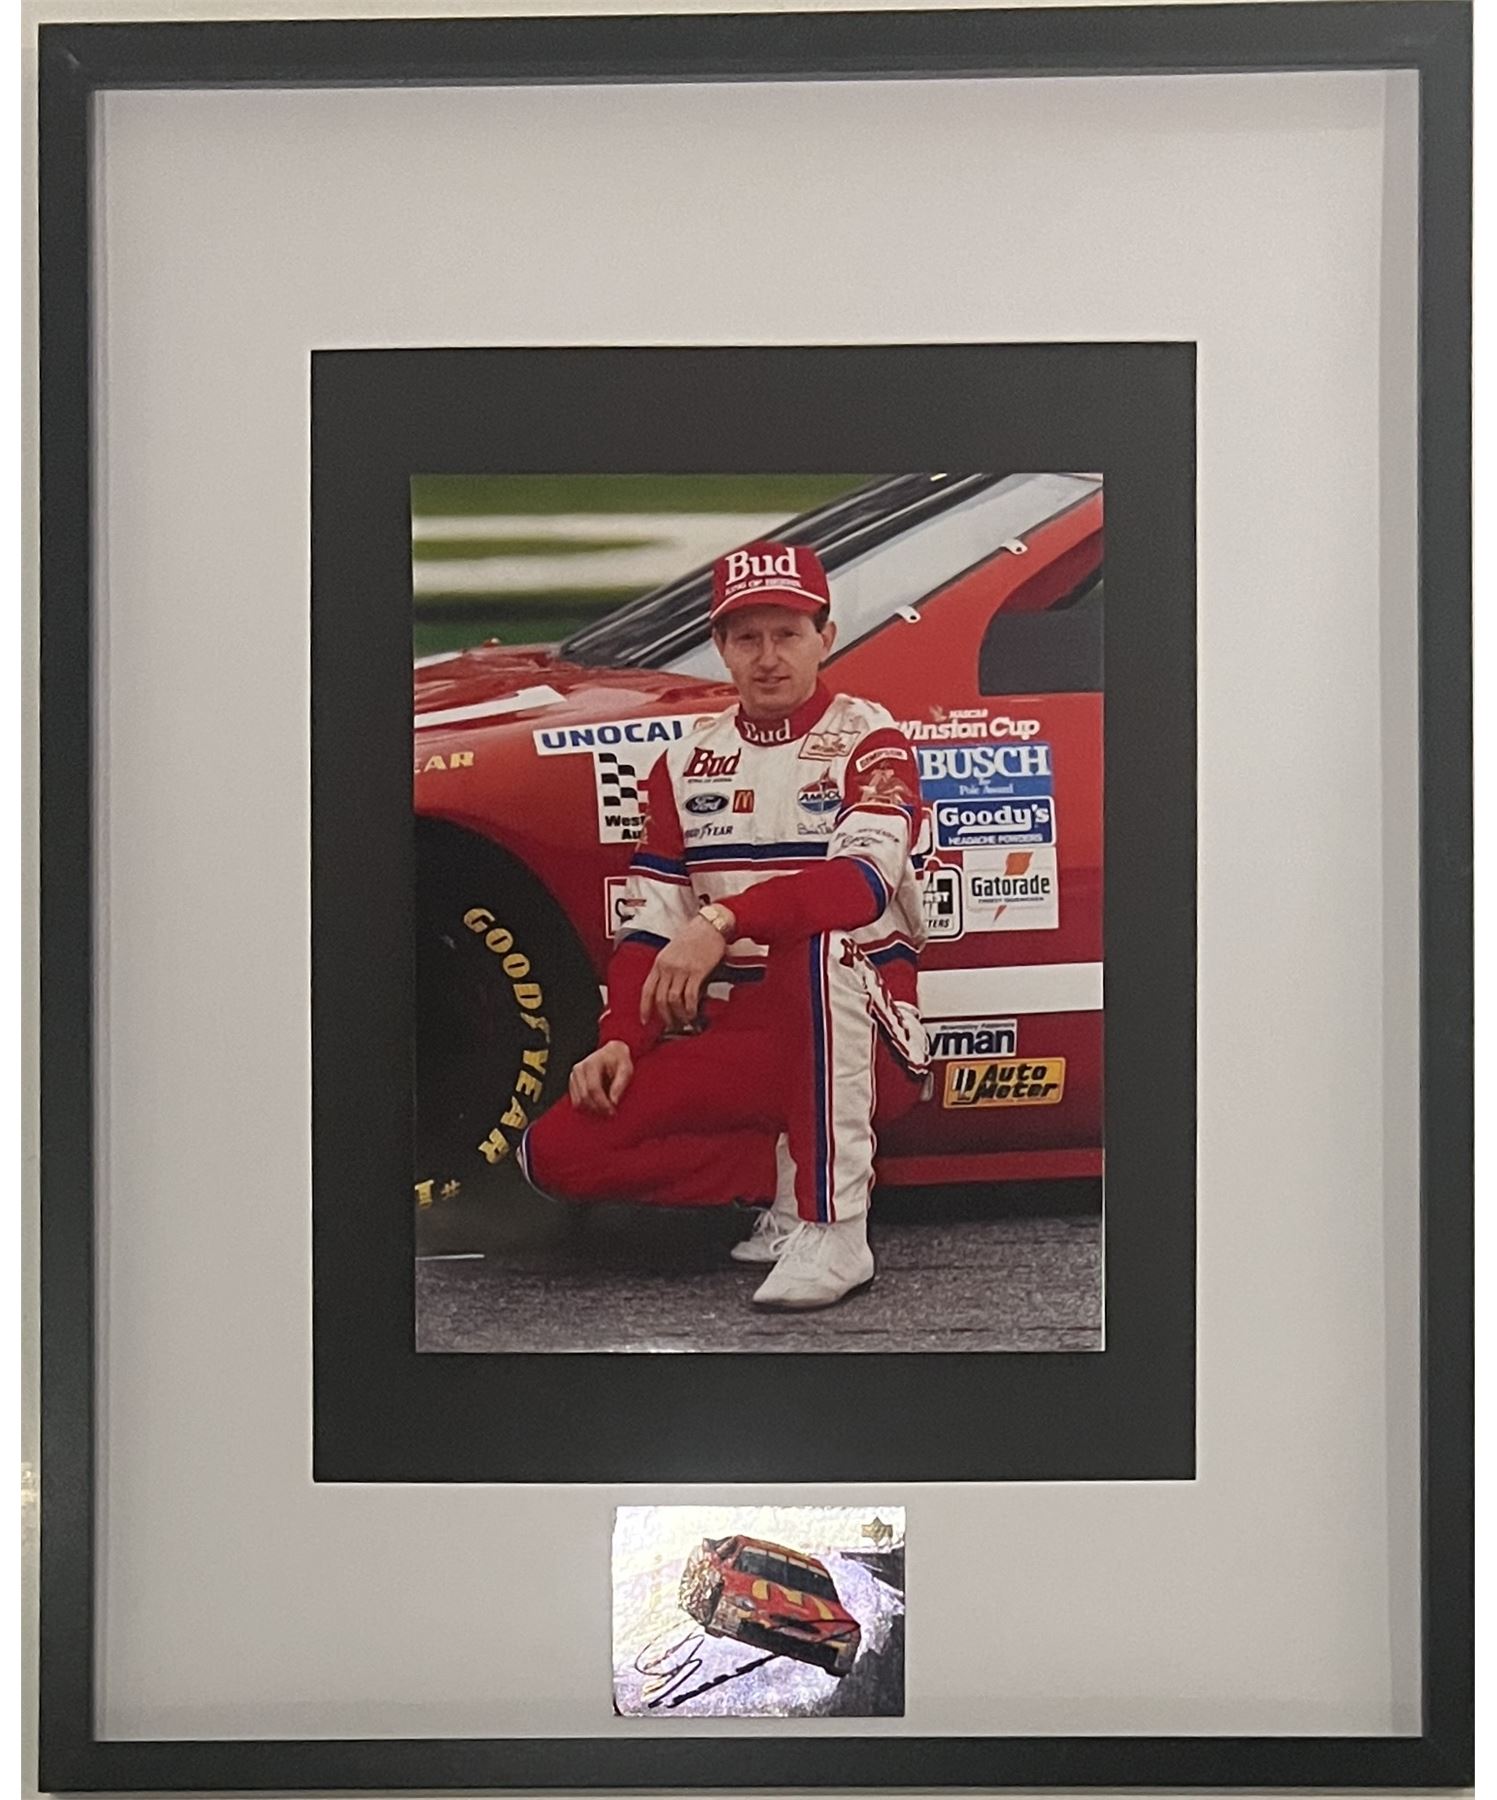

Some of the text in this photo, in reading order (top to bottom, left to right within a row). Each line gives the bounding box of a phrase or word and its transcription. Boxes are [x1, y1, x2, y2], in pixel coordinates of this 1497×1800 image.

[725, 547, 801, 586] Bud
[989, 717, 1040, 740] Cup
[414, 752, 474, 773] AR
[683, 747, 742, 777] Bud
[919, 746, 1051, 780] BUSCH
[939, 804, 1049, 834] Goody's
[971, 874, 1050, 897] Gatorade
[978, 1064, 1047, 1082] Auto
